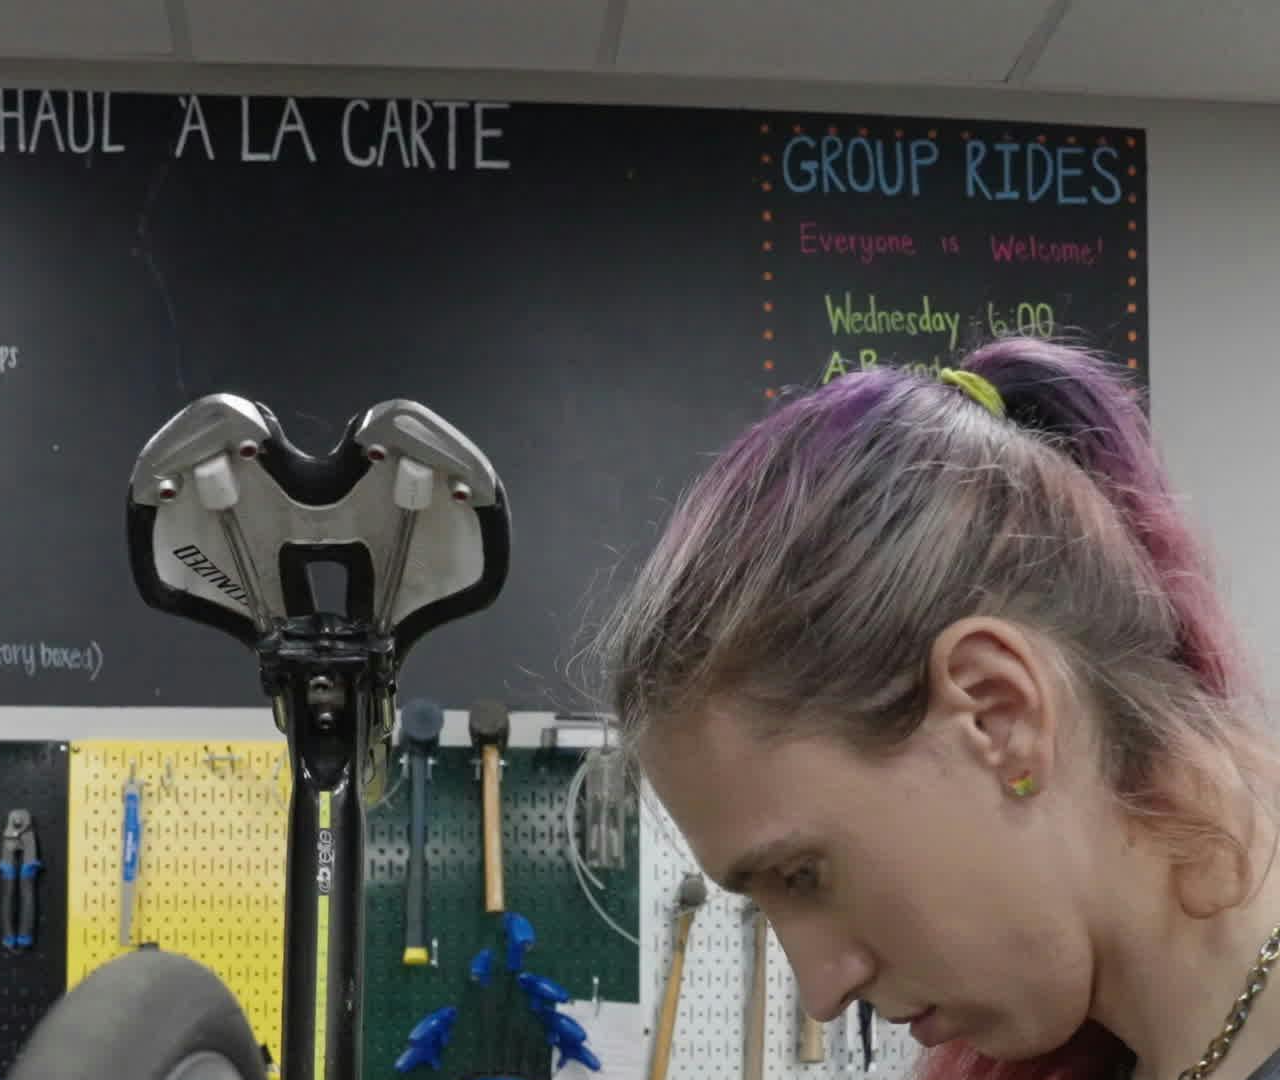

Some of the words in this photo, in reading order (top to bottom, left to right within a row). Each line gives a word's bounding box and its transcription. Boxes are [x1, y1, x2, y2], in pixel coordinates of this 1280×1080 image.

[240, 96, 317, 162] LA
[341, 99, 511, 169] CARTE
[783, 135, 939, 197] GROUP
[966, 139, 1122, 204] RIDES
[799, 222, 917, 264] Everyone
[941, 235, 960, 255] is
[824, 291, 960, 351] Wednesday
